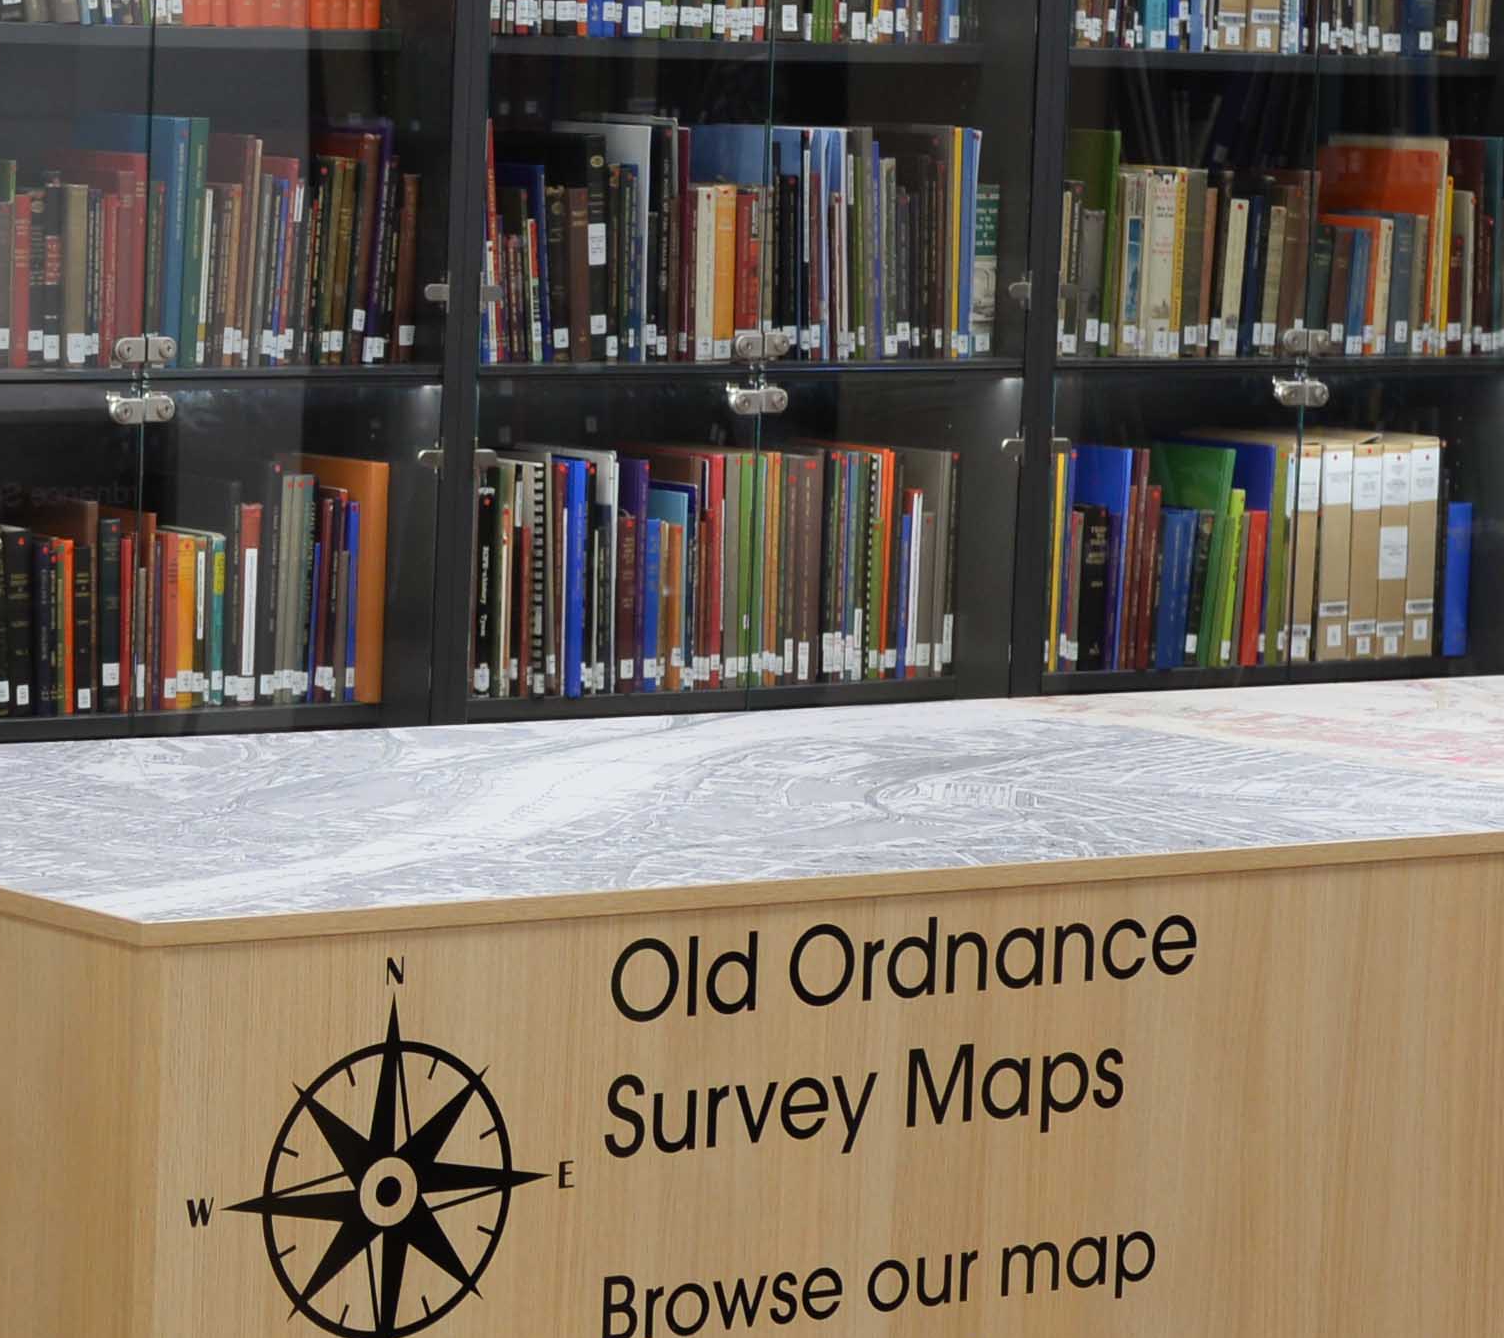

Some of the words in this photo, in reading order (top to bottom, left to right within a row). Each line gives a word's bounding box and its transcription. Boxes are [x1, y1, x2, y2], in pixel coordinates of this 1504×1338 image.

[385, 956, 405, 986] N
[610, 931, 759, 1023] Old
[789, 914, 1197, 1007] Ordnance
[604, 1071, 878, 1159] Survey
[906, 1043, 1124, 1134] Maps
[558, 1160, 575, 1189] E
[186, 1196, 215, 1228] W
[867, 1249, 979, 1313] our
[1000, 1227, 1156, 1299] map
